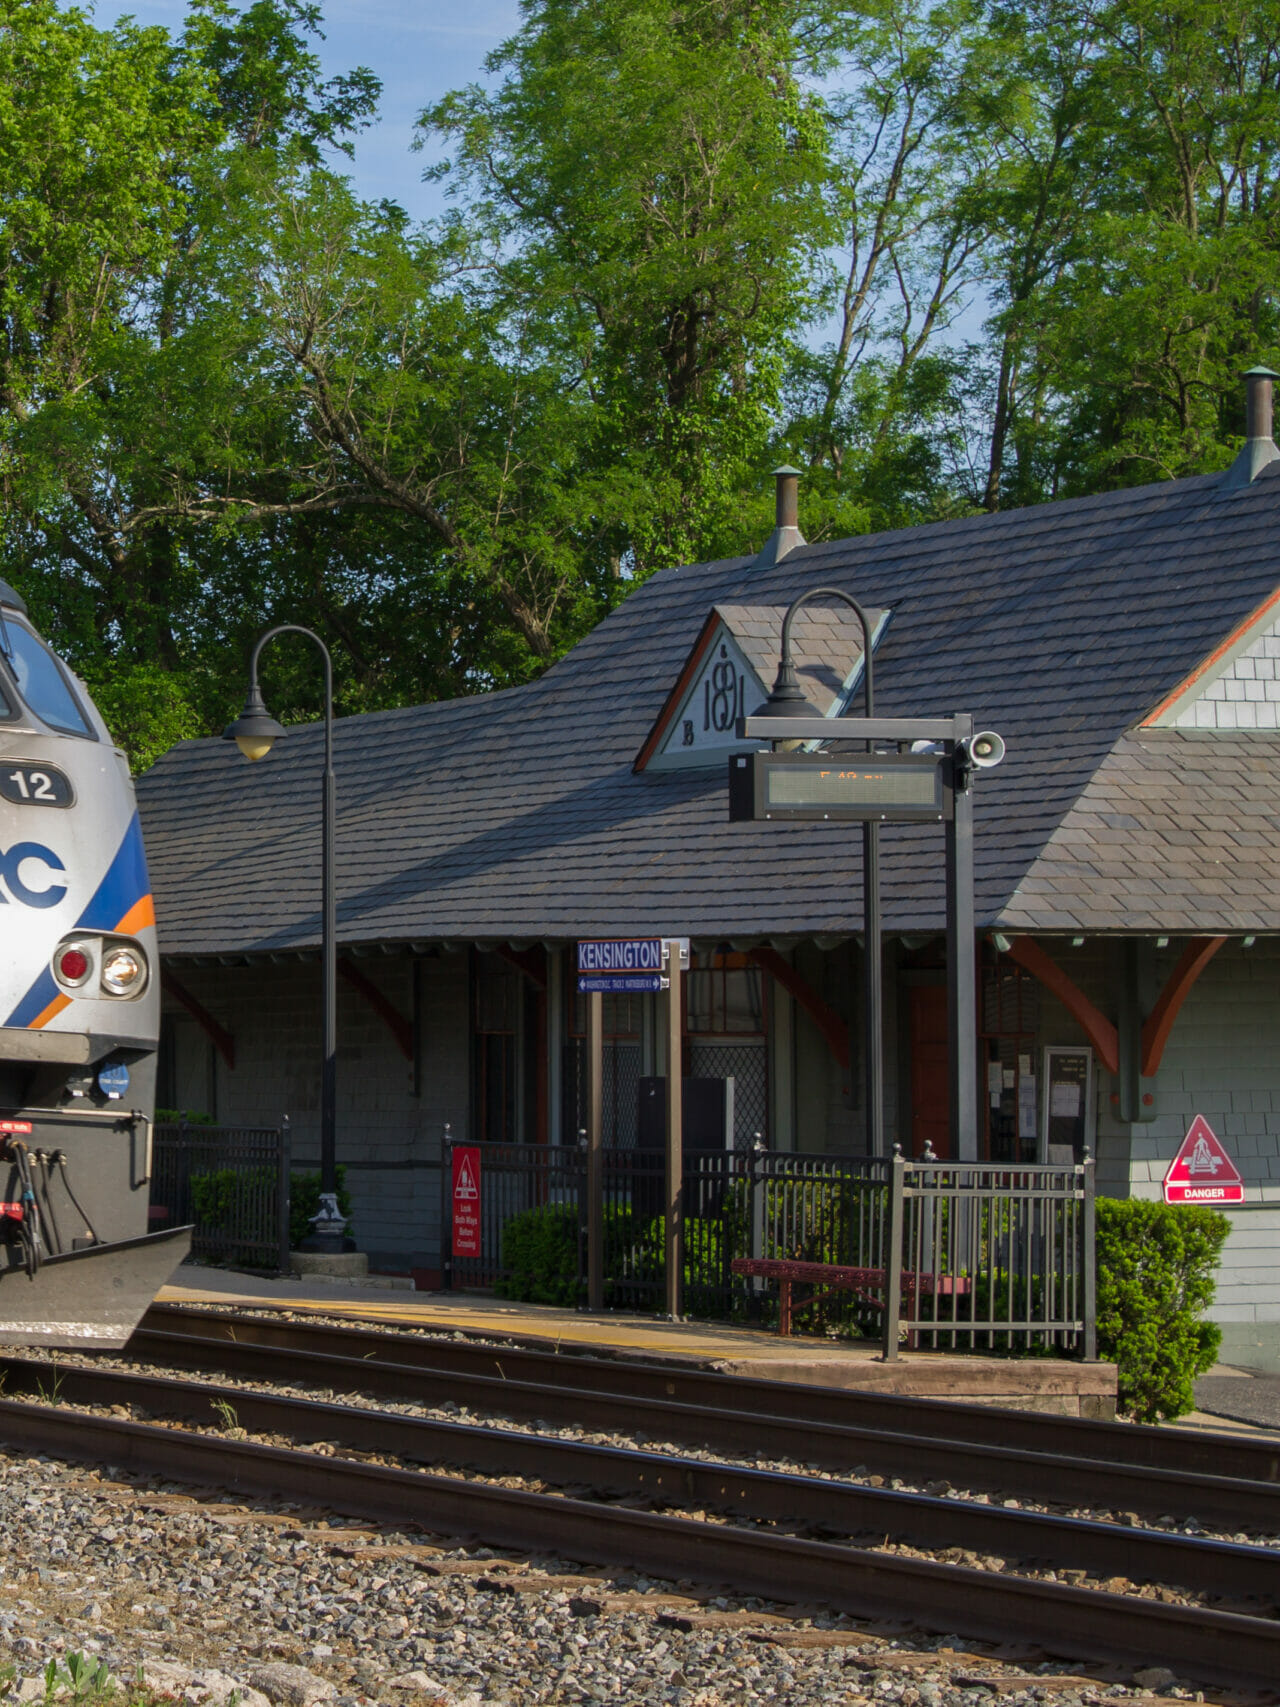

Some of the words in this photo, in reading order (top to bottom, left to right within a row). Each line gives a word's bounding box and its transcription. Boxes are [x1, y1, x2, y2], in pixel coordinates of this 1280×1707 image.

[703, 660, 745, 732] 1891
[682, 720, 694, 746] B
[10, 770, 57, 801] 12
[579, 942, 660, 969] KENSINGTON
[1184, 1188, 1225, 1199] DANGER
[460, 1204, 472, 1213] Look
[455, 1215, 466, 1224] Both
[466, 1216, 478, 1226] Ways
[459, 1227, 473, 1237] Before
[457, 1239, 476, 1250] Crossing
